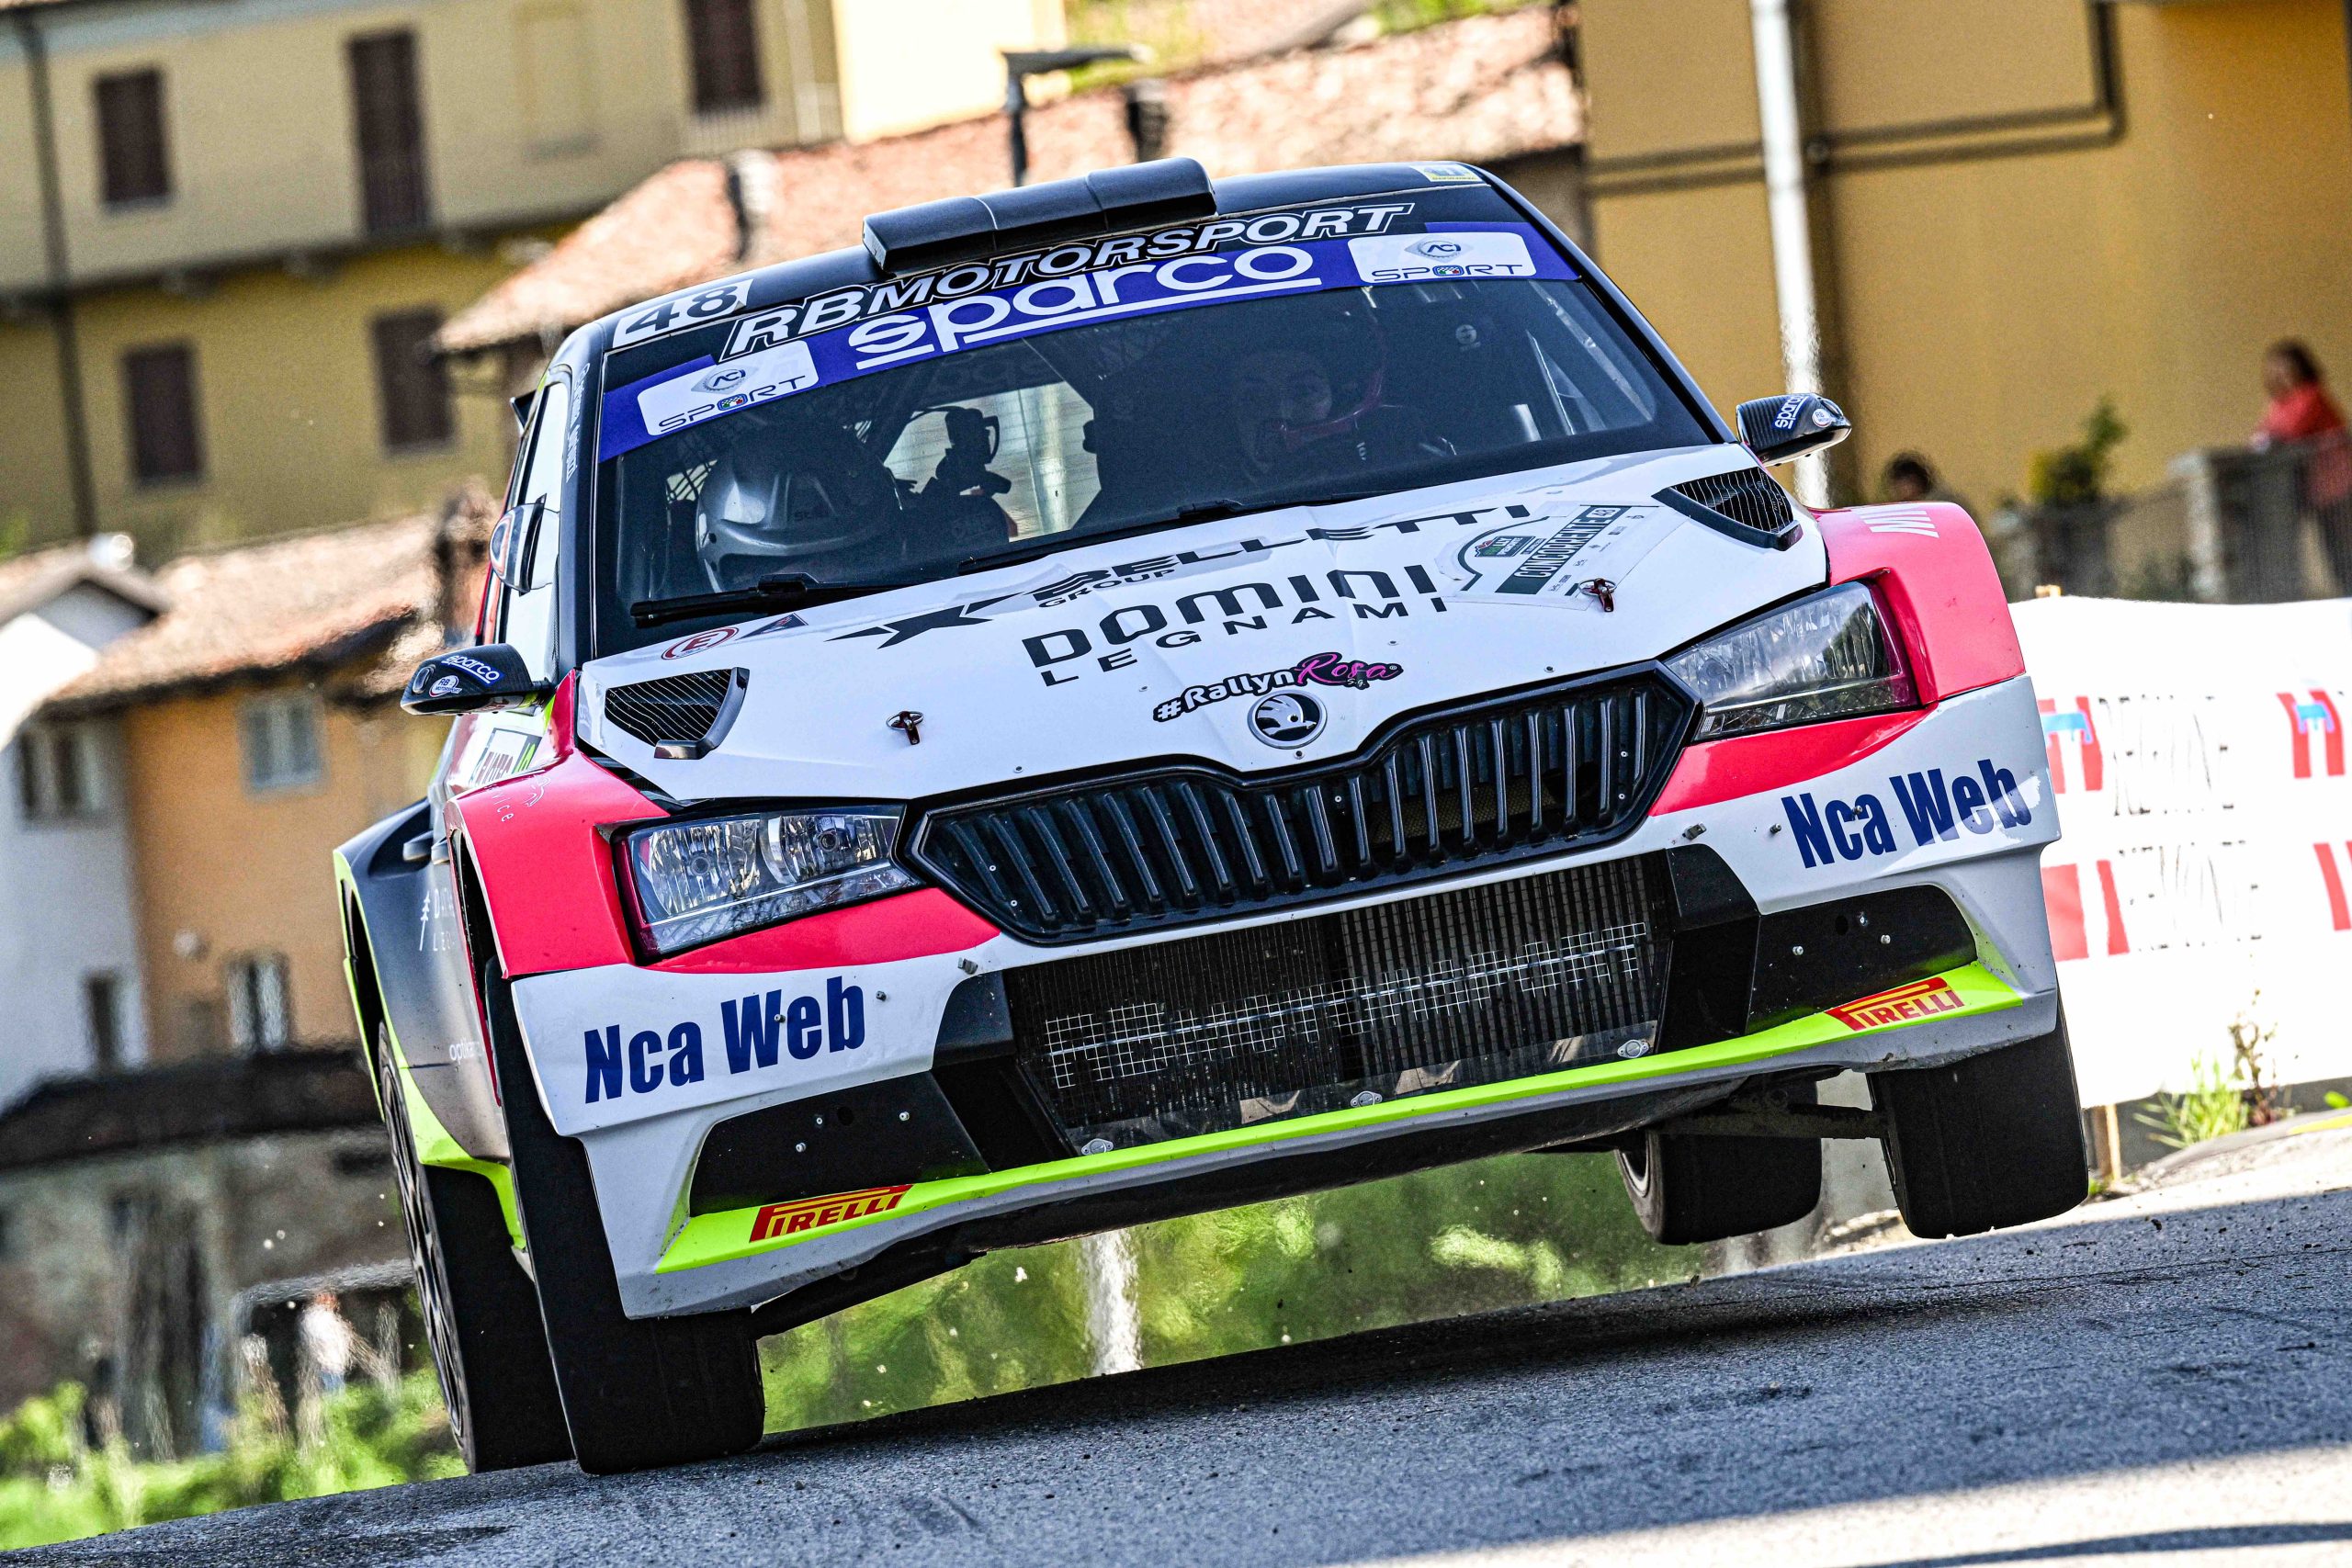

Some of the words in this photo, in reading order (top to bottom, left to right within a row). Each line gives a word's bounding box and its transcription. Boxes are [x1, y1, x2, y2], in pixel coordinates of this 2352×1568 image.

[848, 245, 1314, 356] sparco
[1371, 264, 1523, 282] SPORT
[628, 284, 741, 334] 48
[659, 375, 806, 432] SPORT
[1513, 518, 1613, 579] CONCORRENTE
[1038, 568, 1176, 609] GROUP
[445, 655, 501, 682] sparco
[681, 632, 720, 653] E
[1042, 597, 1448, 687] LEGNAMI
[438, 677, 450, 687] RB
[1781, 792, 1898, 869] Nca
[1889, 759, 2033, 848] Web
[1825, 976, 1965, 1032] PIRELLI
[584, 1021, 705, 1105] Nca
[720, 976, 866, 1076] Web
[749, 1184, 913, 1244] PIRELLI
